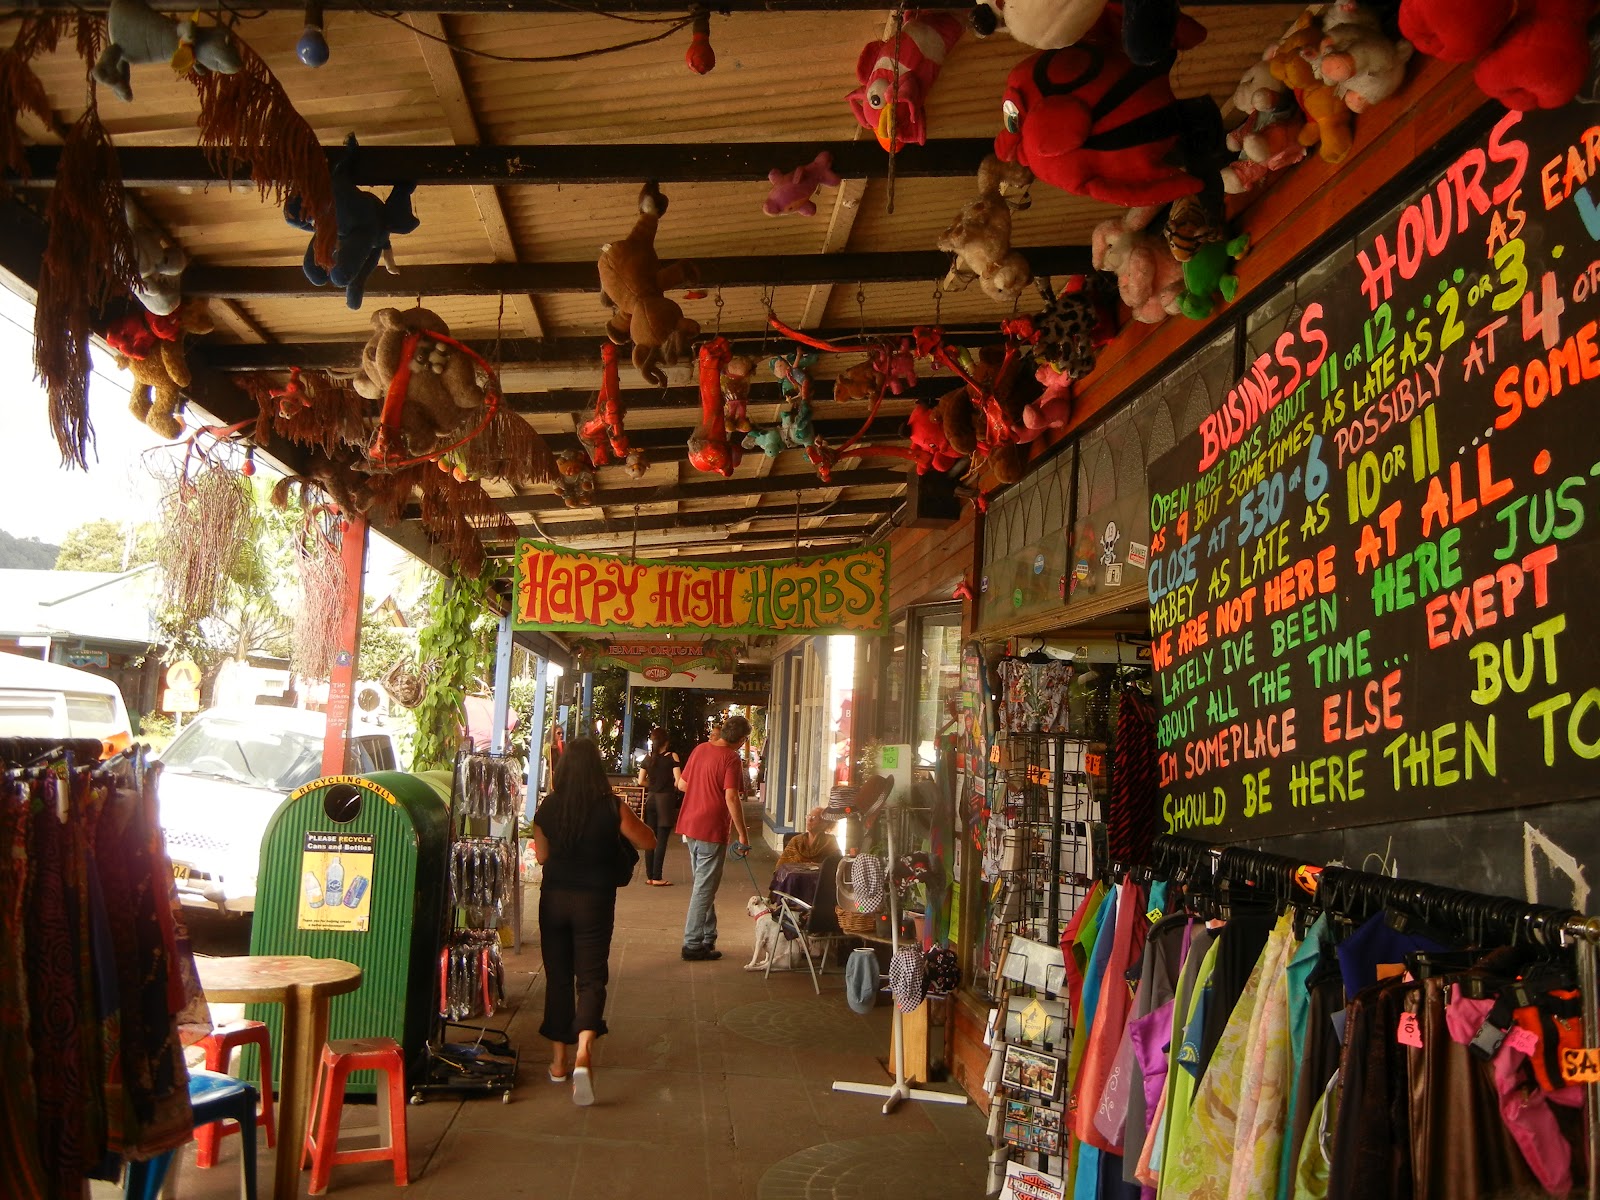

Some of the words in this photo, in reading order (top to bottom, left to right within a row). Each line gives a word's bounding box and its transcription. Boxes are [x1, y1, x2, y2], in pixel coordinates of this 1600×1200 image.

[1151, 483, 1189, 532] OPEN
[1194, 459, 1224, 501] MOST
[1228, 426, 1262, 479] DAYS
[1268, 380, 1311, 444] ABOUT
[1320, 352, 1338, 400] 11
[1344, 343, 1362, 371] OR
[1486, 188, 1526, 259] AS
[1541, 125, 1600, 210] EAR
[1151, 527, 1166, 556] AS
[1177, 511, 1188, 545] 9
[1194, 485, 1222, 531] BUT
[1226, 411, 1314, 505] SOMETIMES
[1322, 389, 1345, 434] AS
[1353, 344, 1395, 411] LATE
[1400, 318, 1432, 374] AS
[1436, 286, 1464, 351] 2
[1468, 274, 1492, 307] OR
[1492, 238, 1528, 311] 3
[1199, 303, 1328, 472] BUSINESS
[1356, 110, 1529, 309] HOURS
[1148, 534, 1200, 604] CLOSE
[1207, 516, 1231, 557] AT
[1288, 466, 1302, 492] OR
[1304, 434, 1328, 502] 6
[1333, 354, 1444, 469] POSSIBLY
[1462, 315, 1508, 382] AT
[1522, 271, 1565, 350] 4
[1150, 578, 1198, 637] MABEY
[1208, 558, 1230, 603] AS
[1240, 520, 1290, 588] LATE
[1300, 493, 1330, 542] AS
[1346, 451, 1381, 525] 10
[1382, 445, 1406, 485] OR
[1410, 403, 1440, 483] 11
[608, 645, 704, 657] EMPORIUM
[1151, 630, 1173, 671] WE
[1178, 611, 1209, 656] ARE
[1216, 587, 1257, 637] NOT
[1264, 545, 1336, 616] HERE
[1355, 500, 1402, 575] AT
[1157, 695, 1198, 749] ABOUT
[1206, 684, 1239, 726] ALL
[1248, 662, 1291, 708] THE
[1426, 544, 1558, 650] EXEPT
[1161, 648, 1213, 707] LATELY
[1221, 630, 1255, 675] IVE
[1271, 593, 1337, 658] BEEN
[1371, 527, 1462, 617] HERE
[1494, 461, 1600, 560] JUS
[299, 776, 362, 795] RECYCLING
[1158, 751, 1178, 788] IM
[1184, 707, 1296, 779] SOMEPLACE
[1323, 669, 1403, 744] ELSE
[1468, 614, 1566, 705] BUT
[1162, 786, 1226, 835] SHOULD
[1242, 767, 1272, 818] BE
[1289, 748, 1367, 807] HERE
[1383, 714, 1497, 792] THEN
